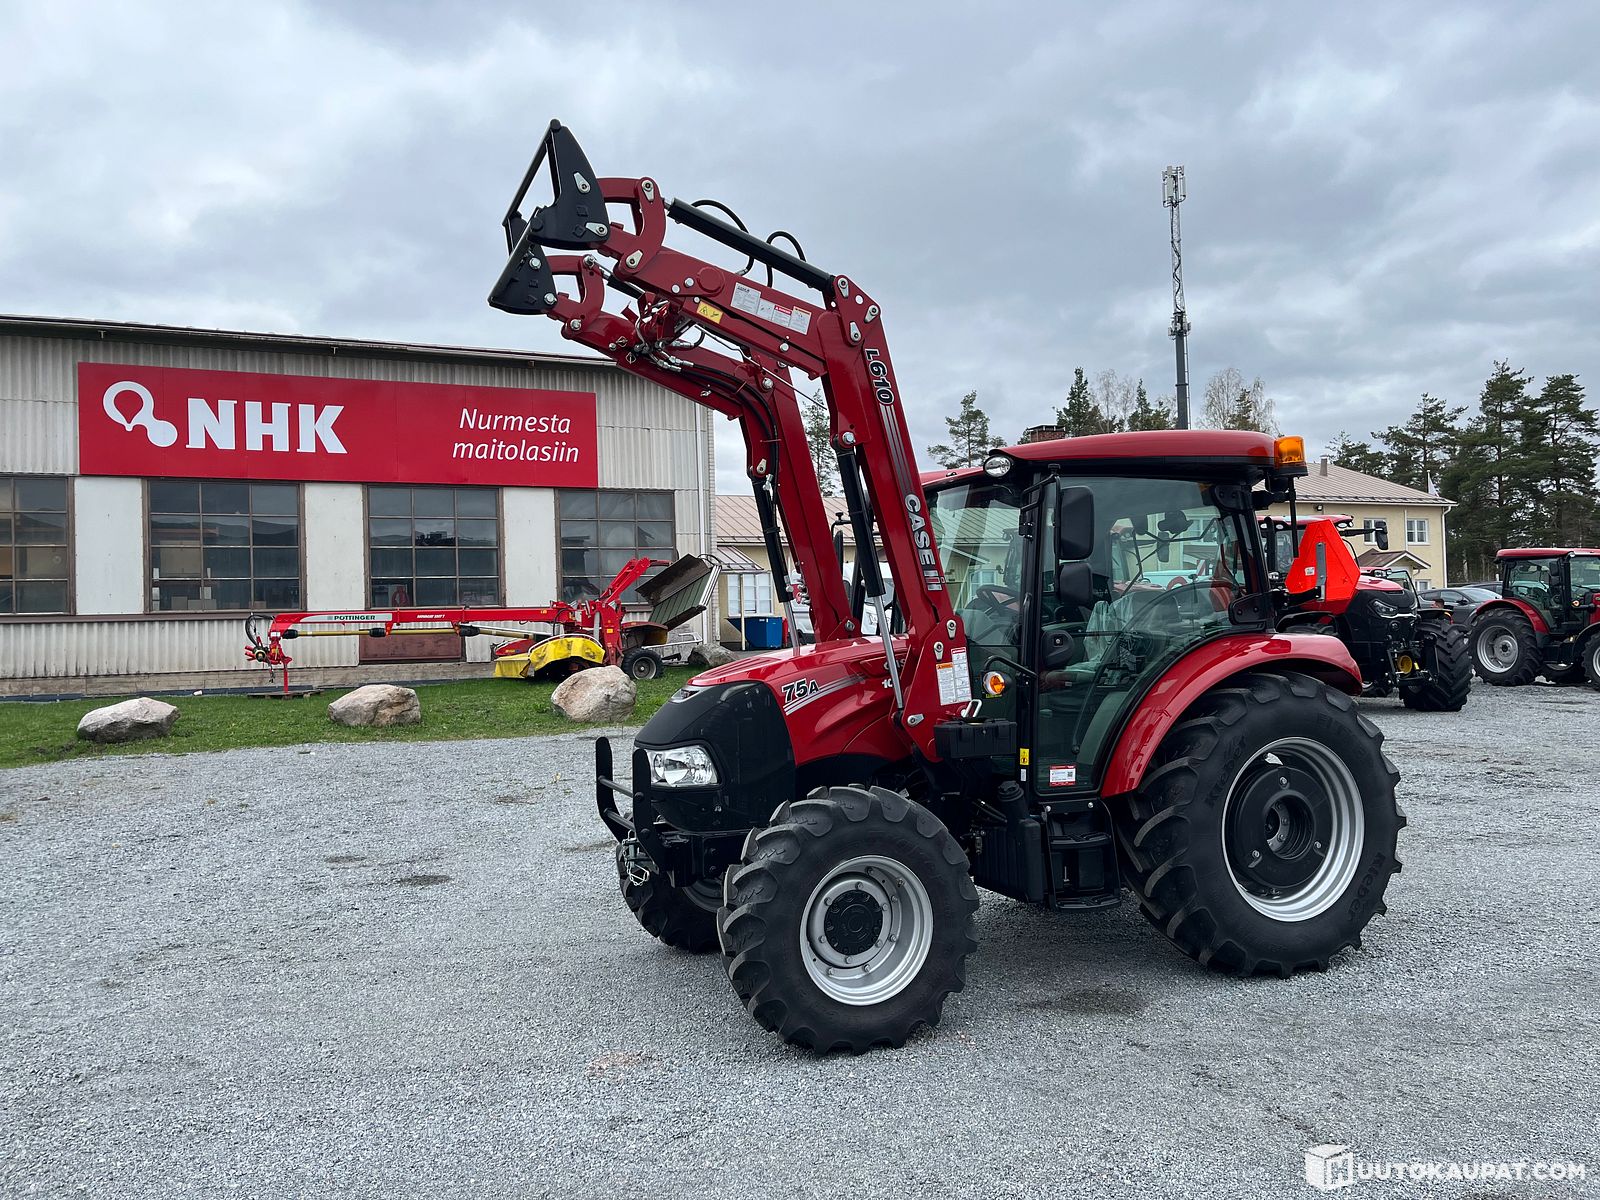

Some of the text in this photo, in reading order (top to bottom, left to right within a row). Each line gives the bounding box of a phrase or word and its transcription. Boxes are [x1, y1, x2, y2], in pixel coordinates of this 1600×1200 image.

[865, 348, 894, 405] L610
[186, 398, 348, 454] NHK
[459, 408, 571, 434] Nurmesta
[452, 438, 579, 463] maitolasiin
[904, 493, 936, 566] CASE
[782, 678, 820, 704] 75A
